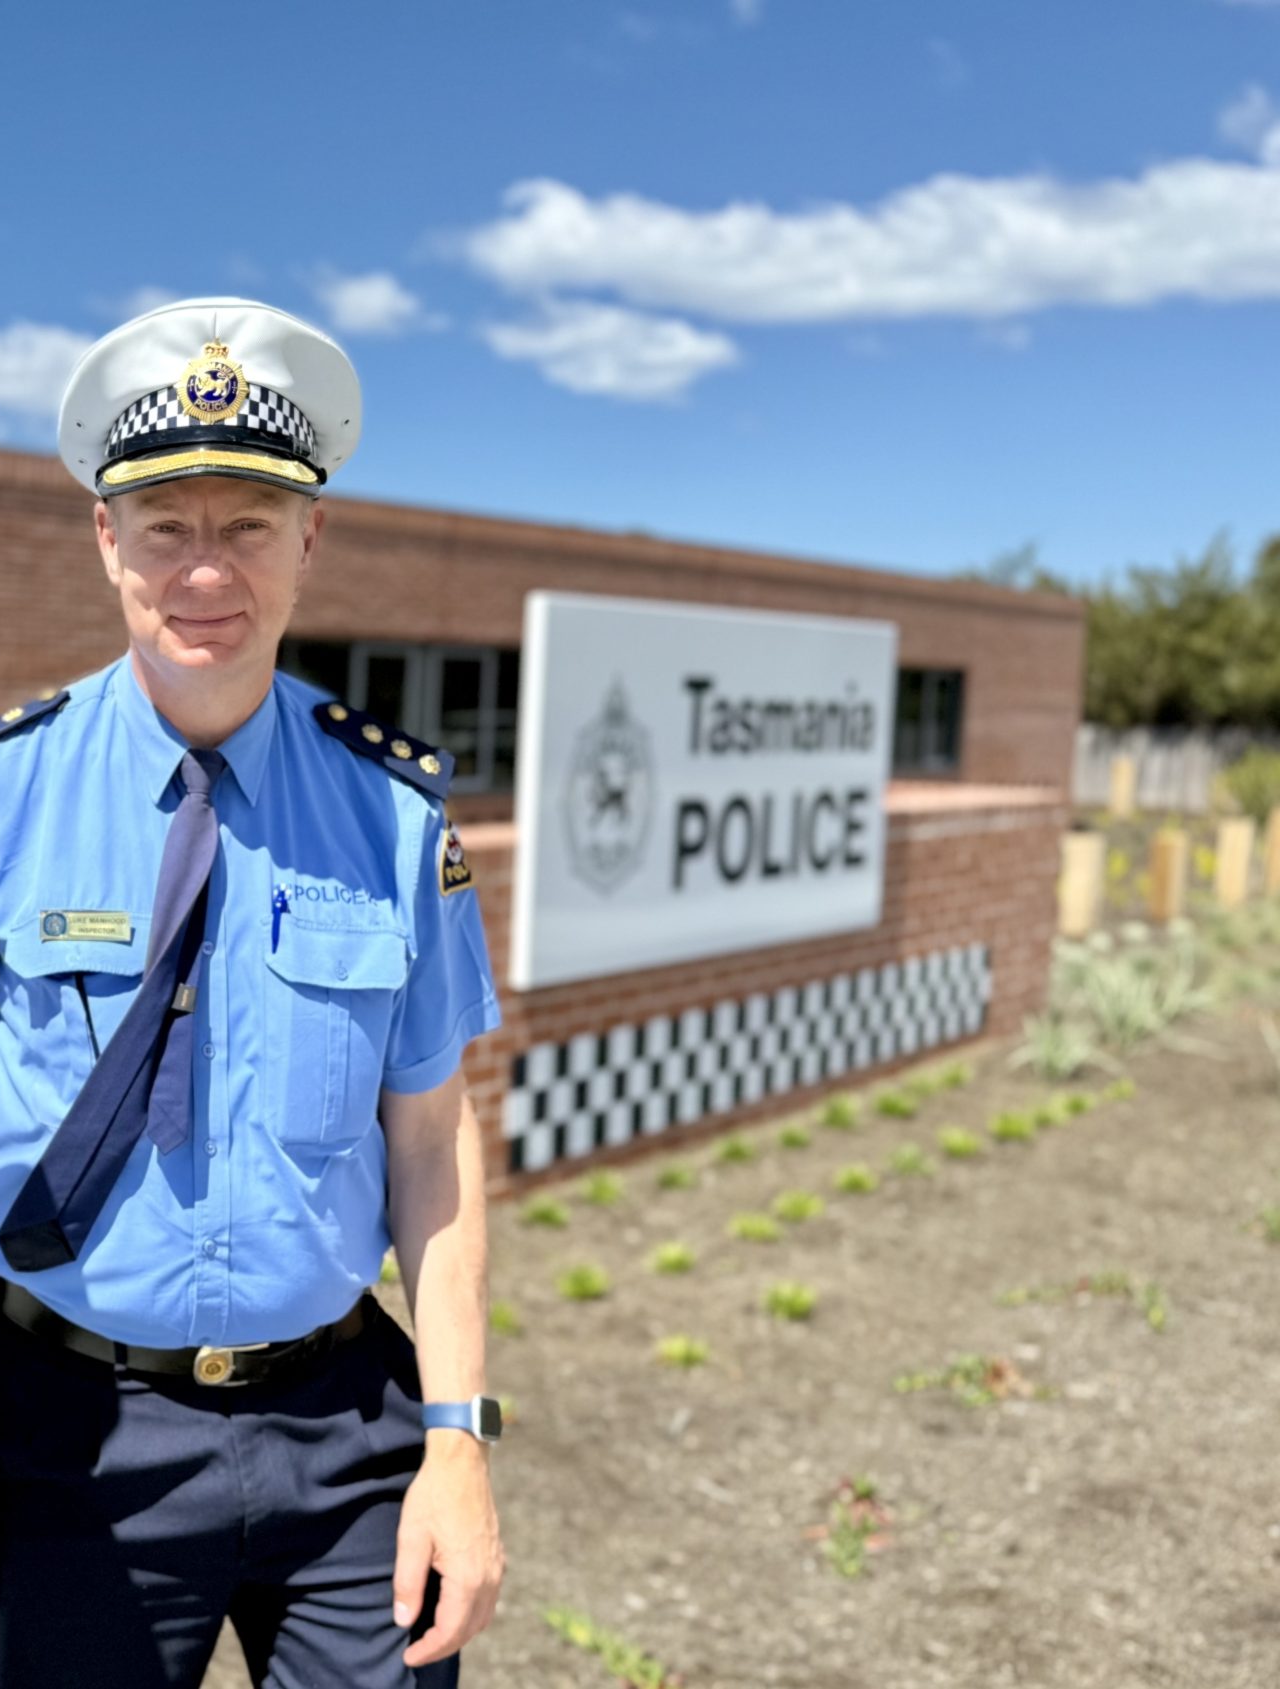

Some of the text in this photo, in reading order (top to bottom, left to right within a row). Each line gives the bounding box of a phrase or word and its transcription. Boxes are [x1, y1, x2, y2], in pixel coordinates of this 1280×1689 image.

[194, 398, 228, 412] POLICE
[684, 675, 876, 756] Tasmania
[672, 788, 868, 892] POLICE
[294, 885, 366, 904] POLICE
